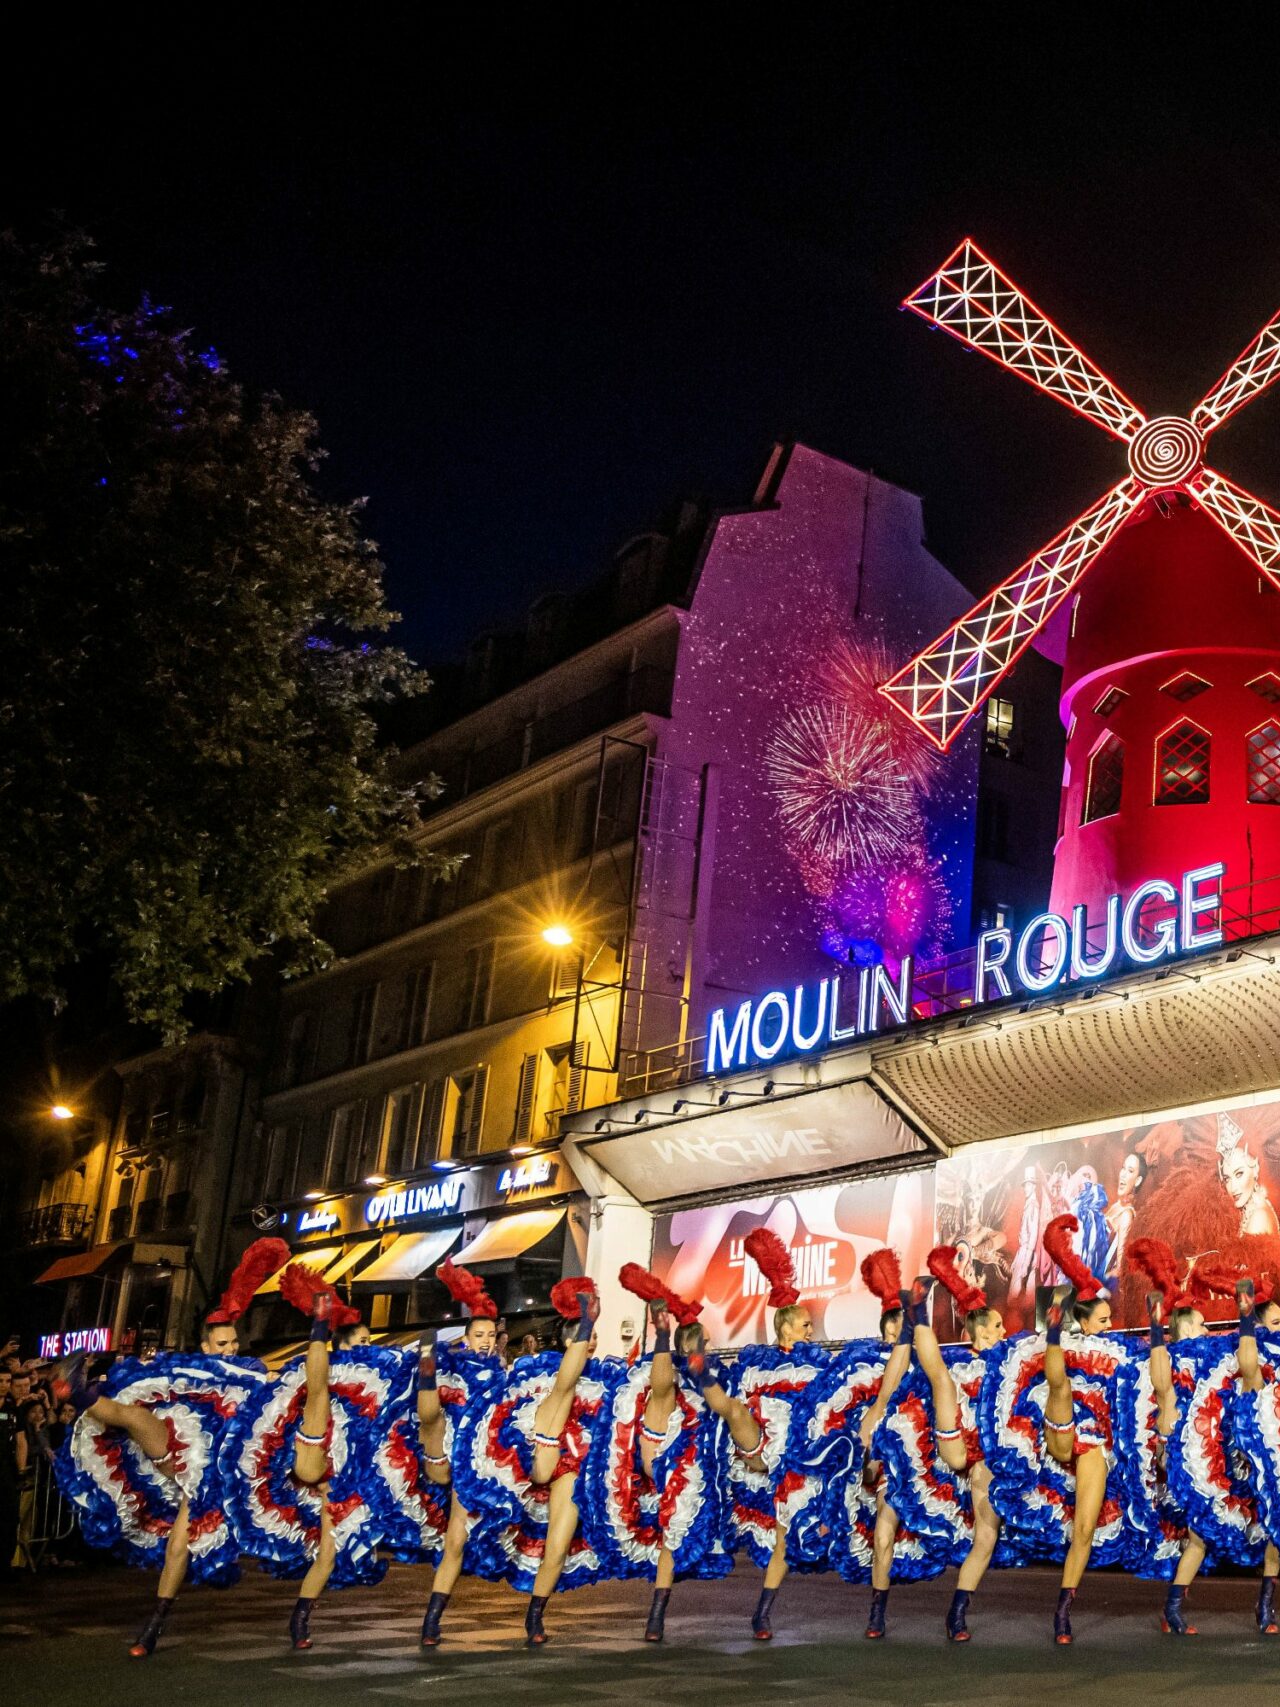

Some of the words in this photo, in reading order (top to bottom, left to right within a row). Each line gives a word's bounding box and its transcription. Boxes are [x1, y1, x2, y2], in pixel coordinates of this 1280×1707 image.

[705, 953, 912, 1073] MOULIN
[974, 862, 1226, 1004] ROUGE
[40, 1334, 60, 1358] THE
[63, 1327, 109, 1356] STATION
